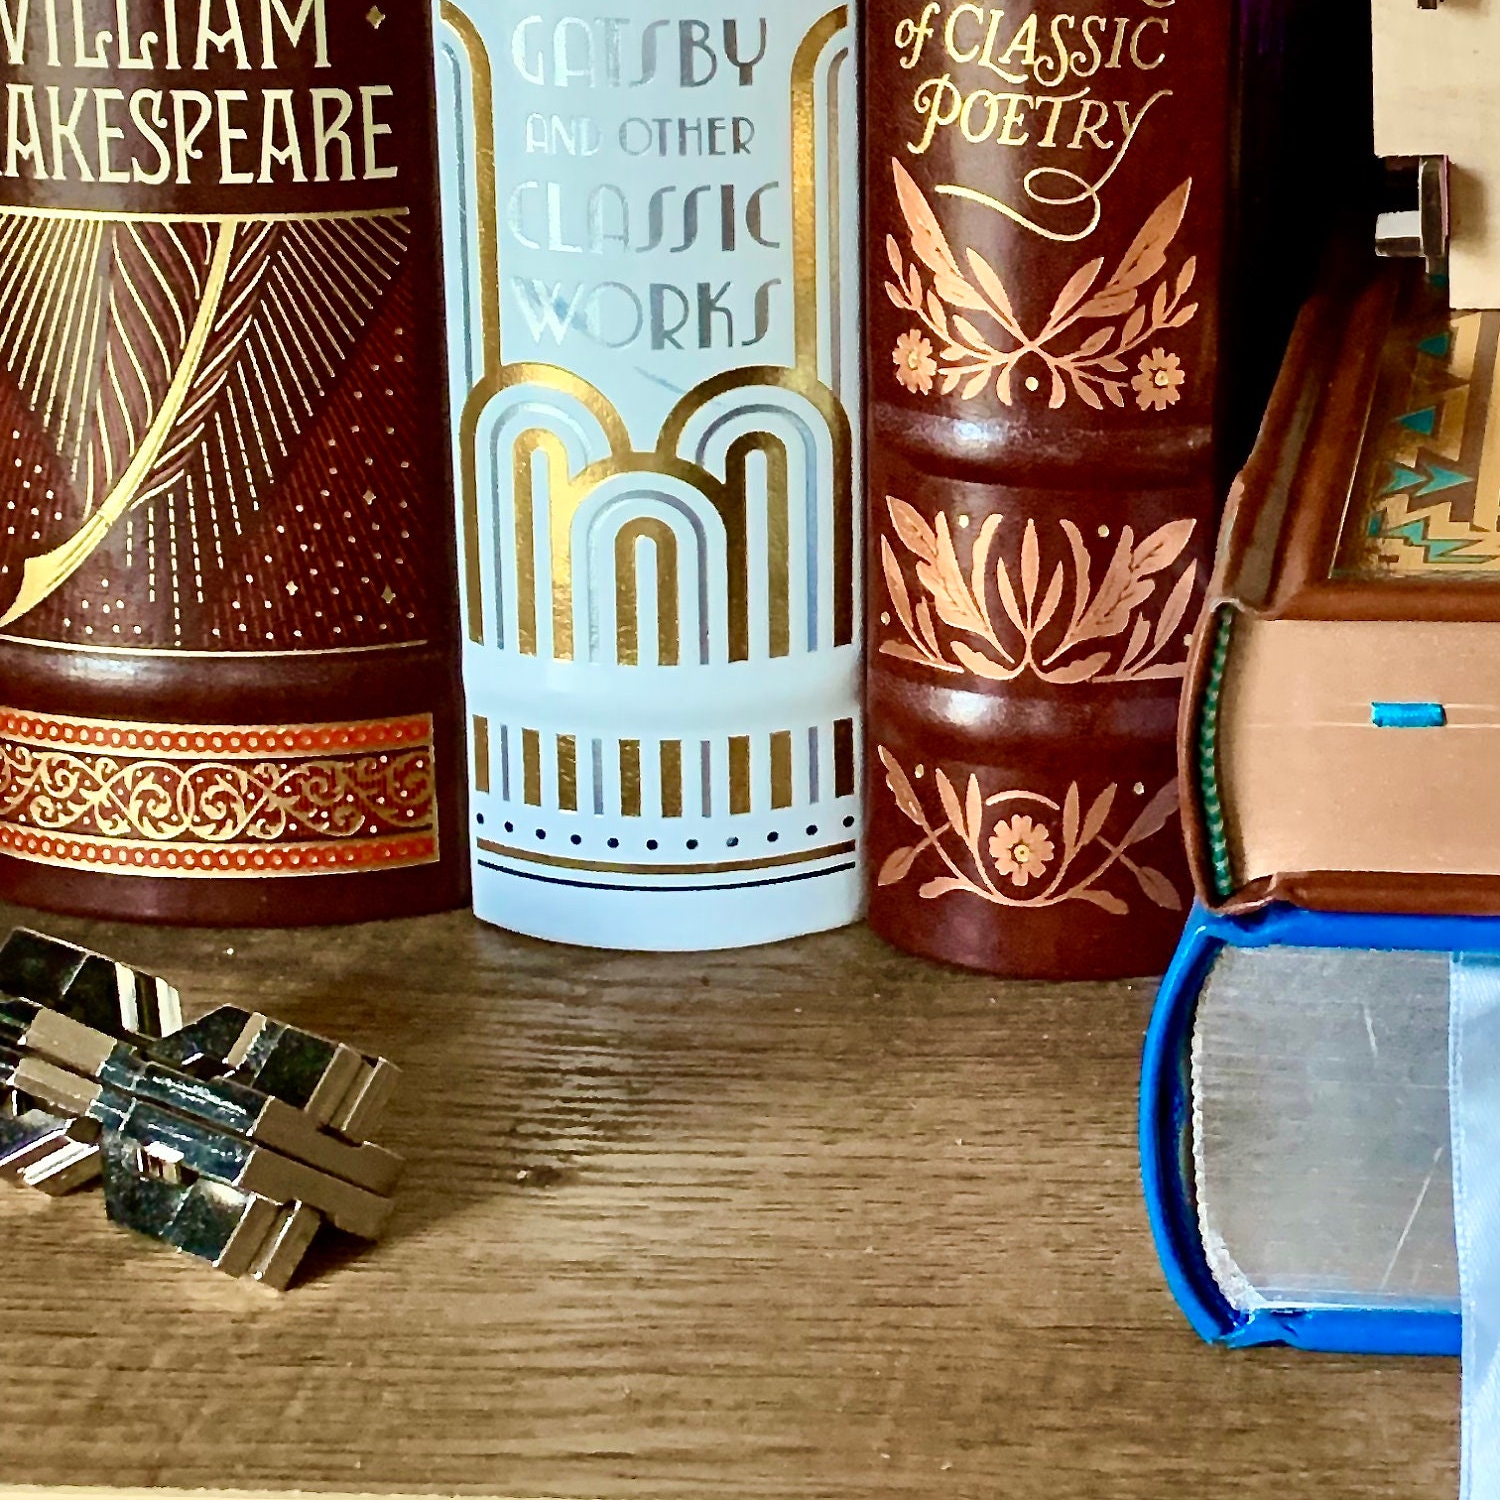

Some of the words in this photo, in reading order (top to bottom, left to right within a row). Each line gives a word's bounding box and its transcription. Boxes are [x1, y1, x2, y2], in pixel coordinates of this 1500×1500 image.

[511, 14, 768, 88] GATSBY
[895, 1, 941, 70] of
[944, 3, 1169, 87] CLASSIC
[0, 84, 398, 185] AKESPEARE
[526, 112, 600, 155] AND
[618, 116, 755, 156] OTHER
[907, 73, 1173, 205] POETRY
[508, 181, 780, 253] CLASSIC
[510, 277, 782, 351] WORKS
